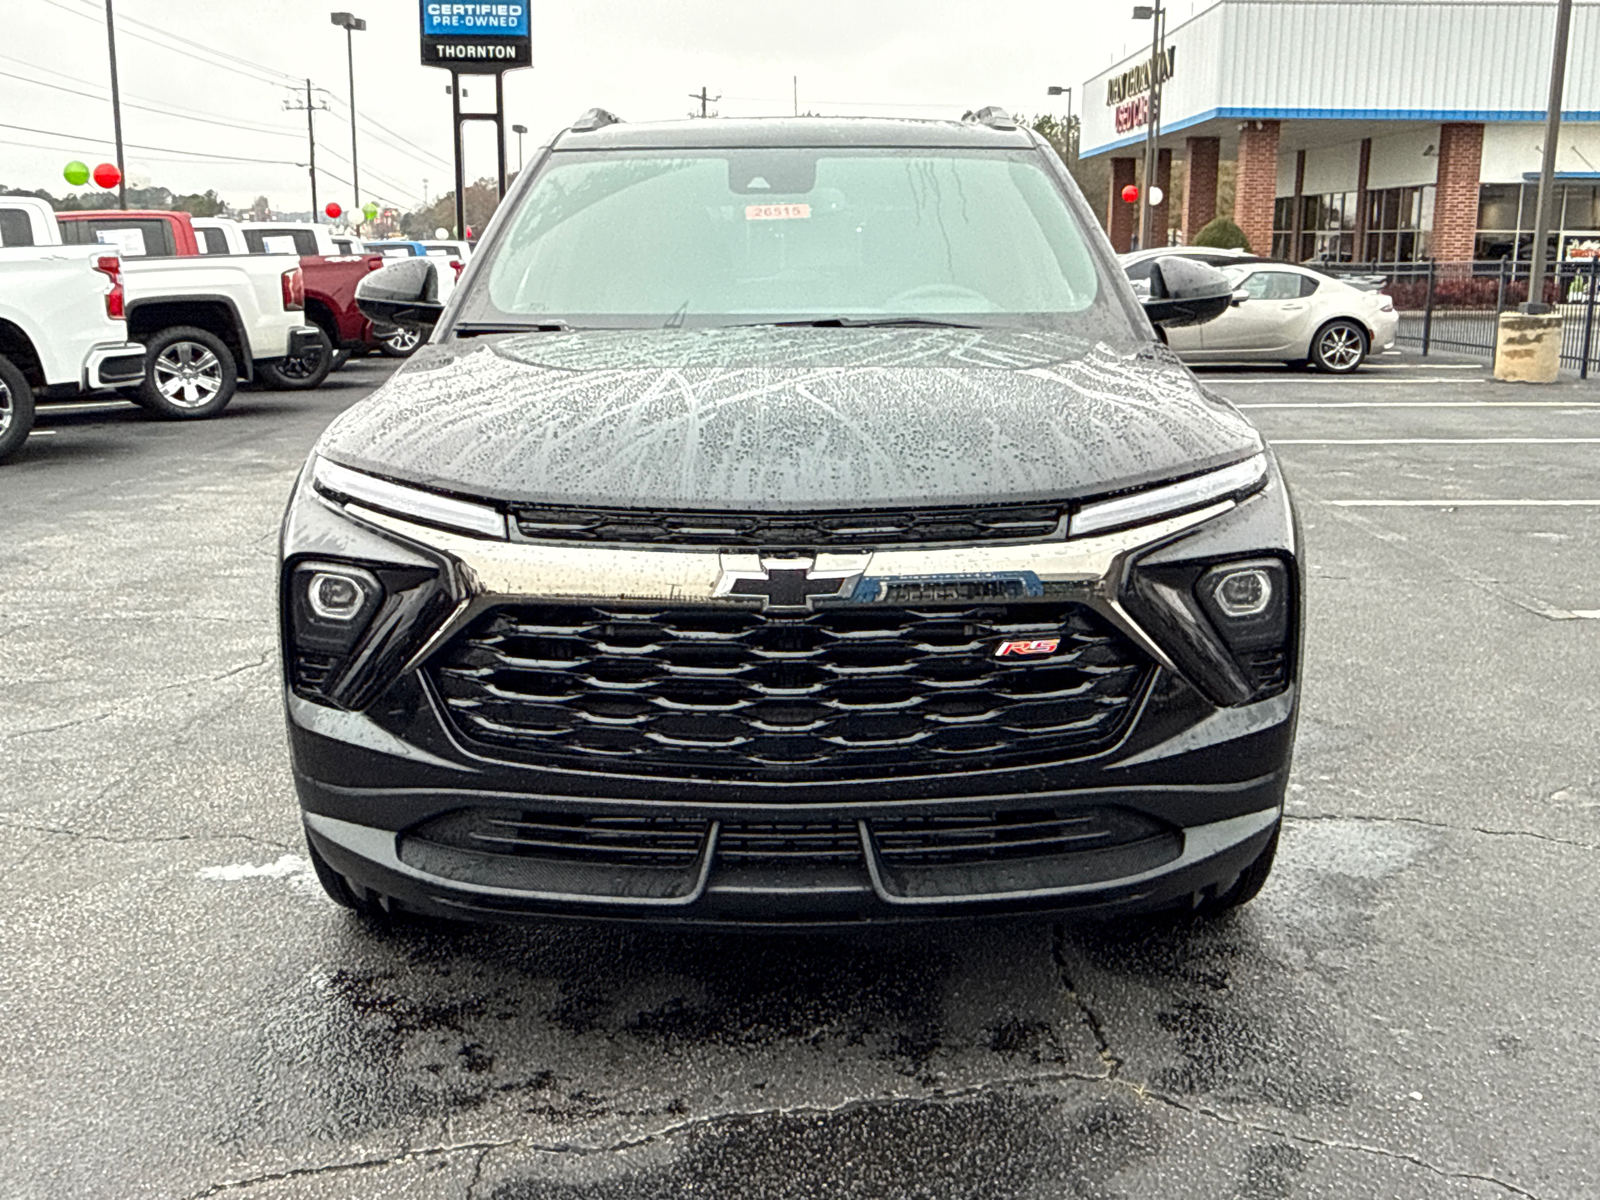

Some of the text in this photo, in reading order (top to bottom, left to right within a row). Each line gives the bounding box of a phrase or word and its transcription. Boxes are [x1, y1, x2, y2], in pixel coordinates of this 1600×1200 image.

[427, 4, 522, 15] CERTIFIED
[432, 16, 518, 27] PRE-OWNED
[436, 45, 516, 59] THORNTON
[1127, 46, 1176, 97] THORNON
[994, 638, 1061, 657] RS
